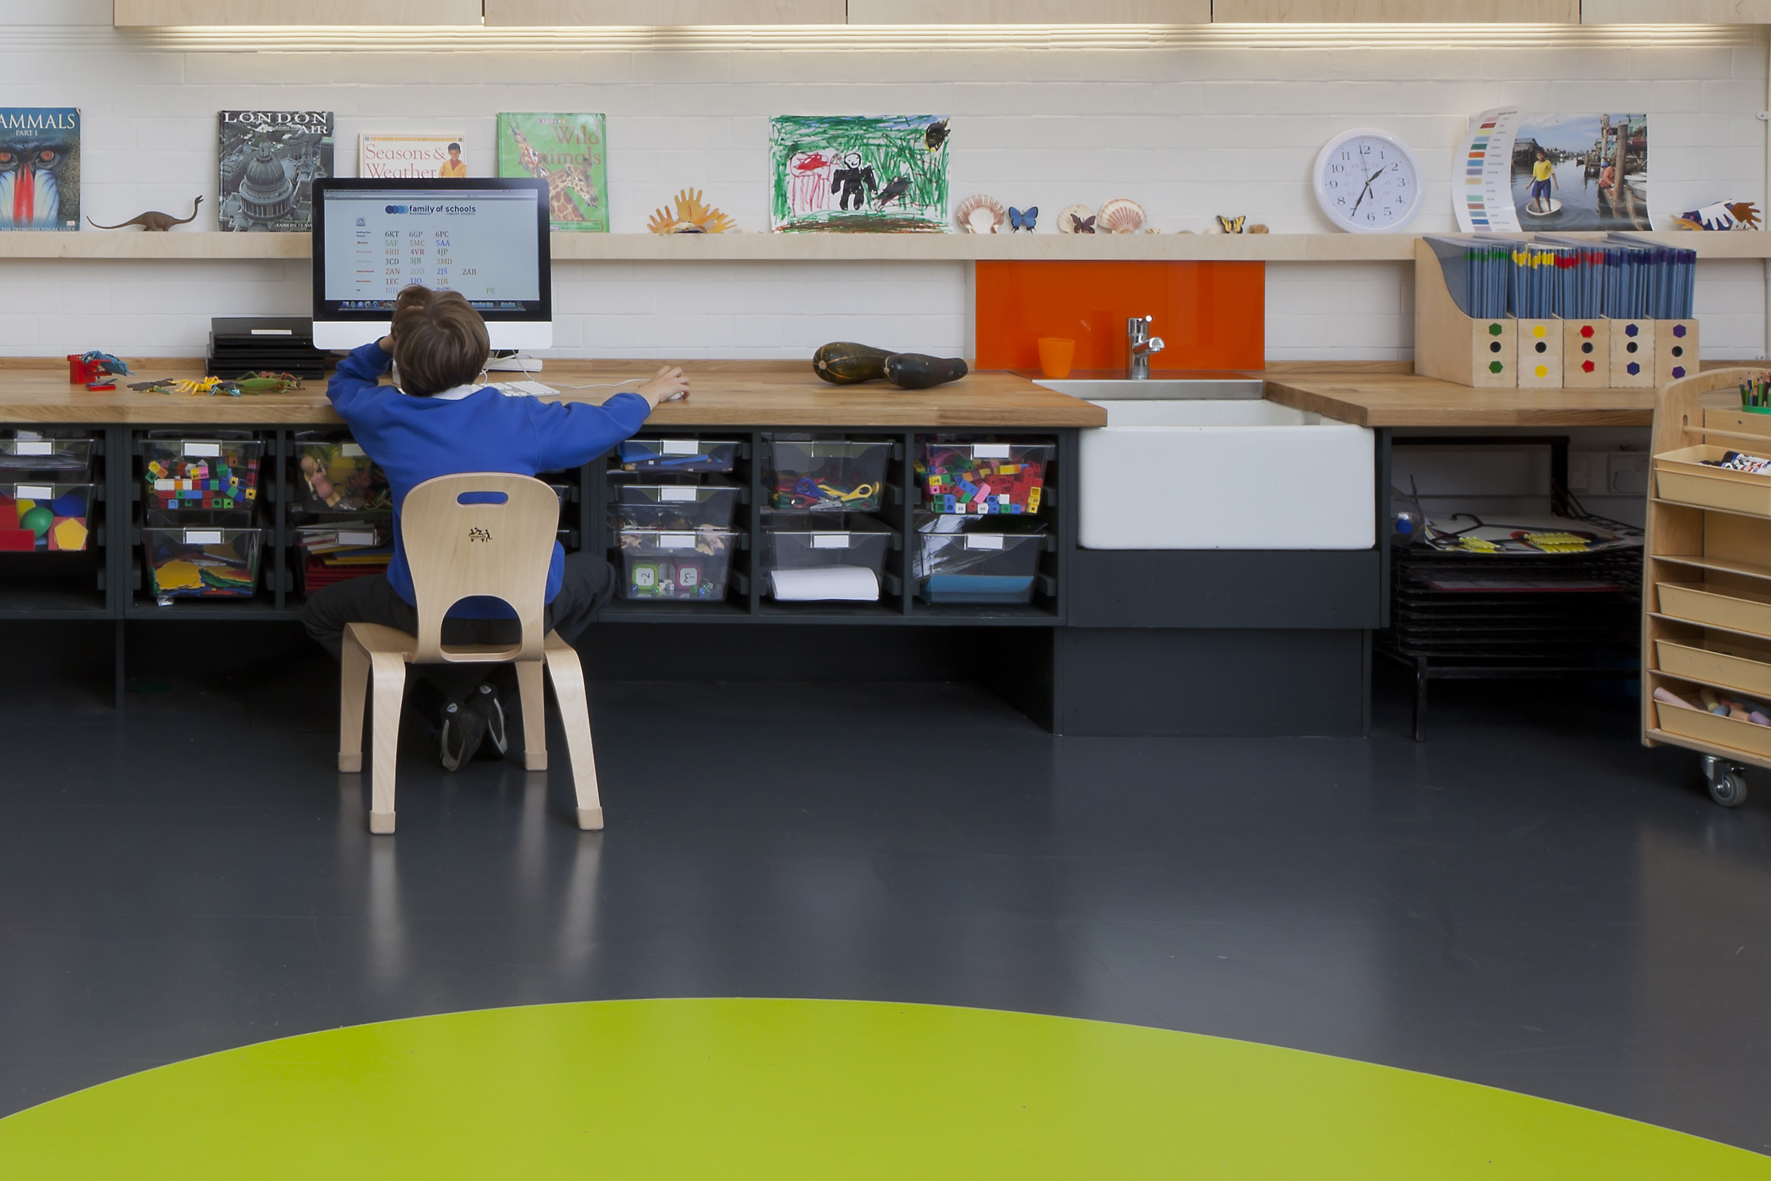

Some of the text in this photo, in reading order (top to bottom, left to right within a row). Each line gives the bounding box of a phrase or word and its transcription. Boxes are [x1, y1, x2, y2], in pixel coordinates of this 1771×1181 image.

[224, 112, 328, 123] LONDON
[298, 125, 328, 133] AIR
[553, 122, 600, 145] Wild
[366, 143, 446, 160] Seasons &
[1358, 145, 1371, 155] 12
[518, 145, 602, 165] Animals
[1342, 151, 1350, 161] 11
[1380, 151, 1384, 159] 1
[366, 163, 437, 178] Weather
[1332, 164, 1344, 173] 10
[1391, 162, 1398, 171] 2
[1330, 180, 1338, 189] 9
[1397, 178, 1406, 187] 3
[1337, 197, 1345, 205] 8
[1396, 195, 1403, 204] 4
[409, 205, 476, 213] family of schools
[1384, 207, 1392, 216] 5
[1367, 213, 1375, 221] 6
